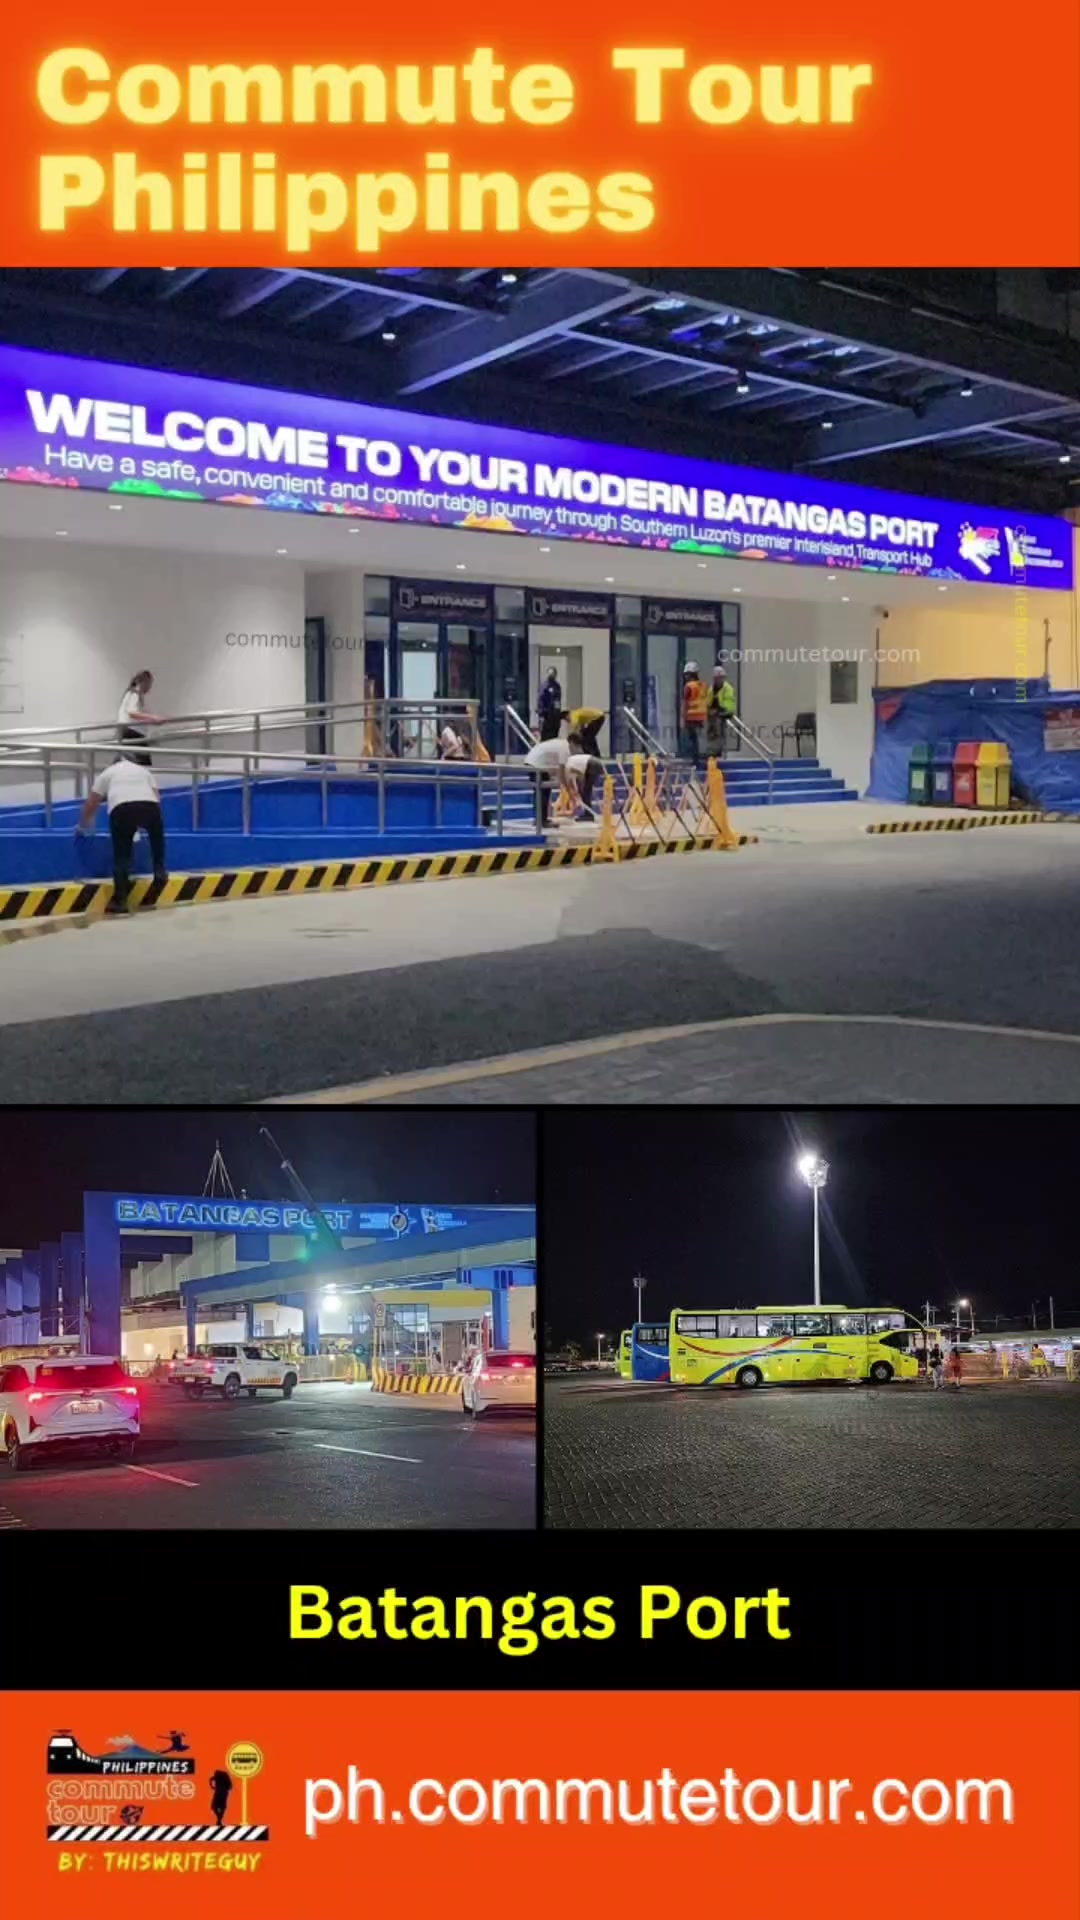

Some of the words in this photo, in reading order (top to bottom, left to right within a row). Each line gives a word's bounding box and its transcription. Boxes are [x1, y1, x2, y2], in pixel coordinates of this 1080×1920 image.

[25, 389, 329, 469] WELCOME
[336, 434, 402, 477] TO
[408, 445, 529, 494] YOUR
[534, 463, 699, 518] MODERN
[703, 488, 867, 539] BATANGAS
[869, 513, 939, 548] PORT
[44, 443, 114, 473] Have
[119, 456, 136, 476] a
[142, 459, 202, 486] safe,
[204, 466, 327, 497] convenient
[330, 481, 369, 501] and
[373, 487, 488, 515] comfortable
[490, 498, 552, 525] journey
[556, 507, 617, 532] through
[620, 514, 688, 538] Southern
[690, 524, 742, 545] Luzon's
[743, 531, 793, 552] premier
[856, 544, 908, 566] Transport
[910, 550, 933, 568] Hub
[420, 595, 487, 609] ENTRANCE
[551, 602, 609, 615] ENTRANCE
[665, 611, 716, 623] ENTRANCE
[117, 1199, 280, 1228] BATANGAS
